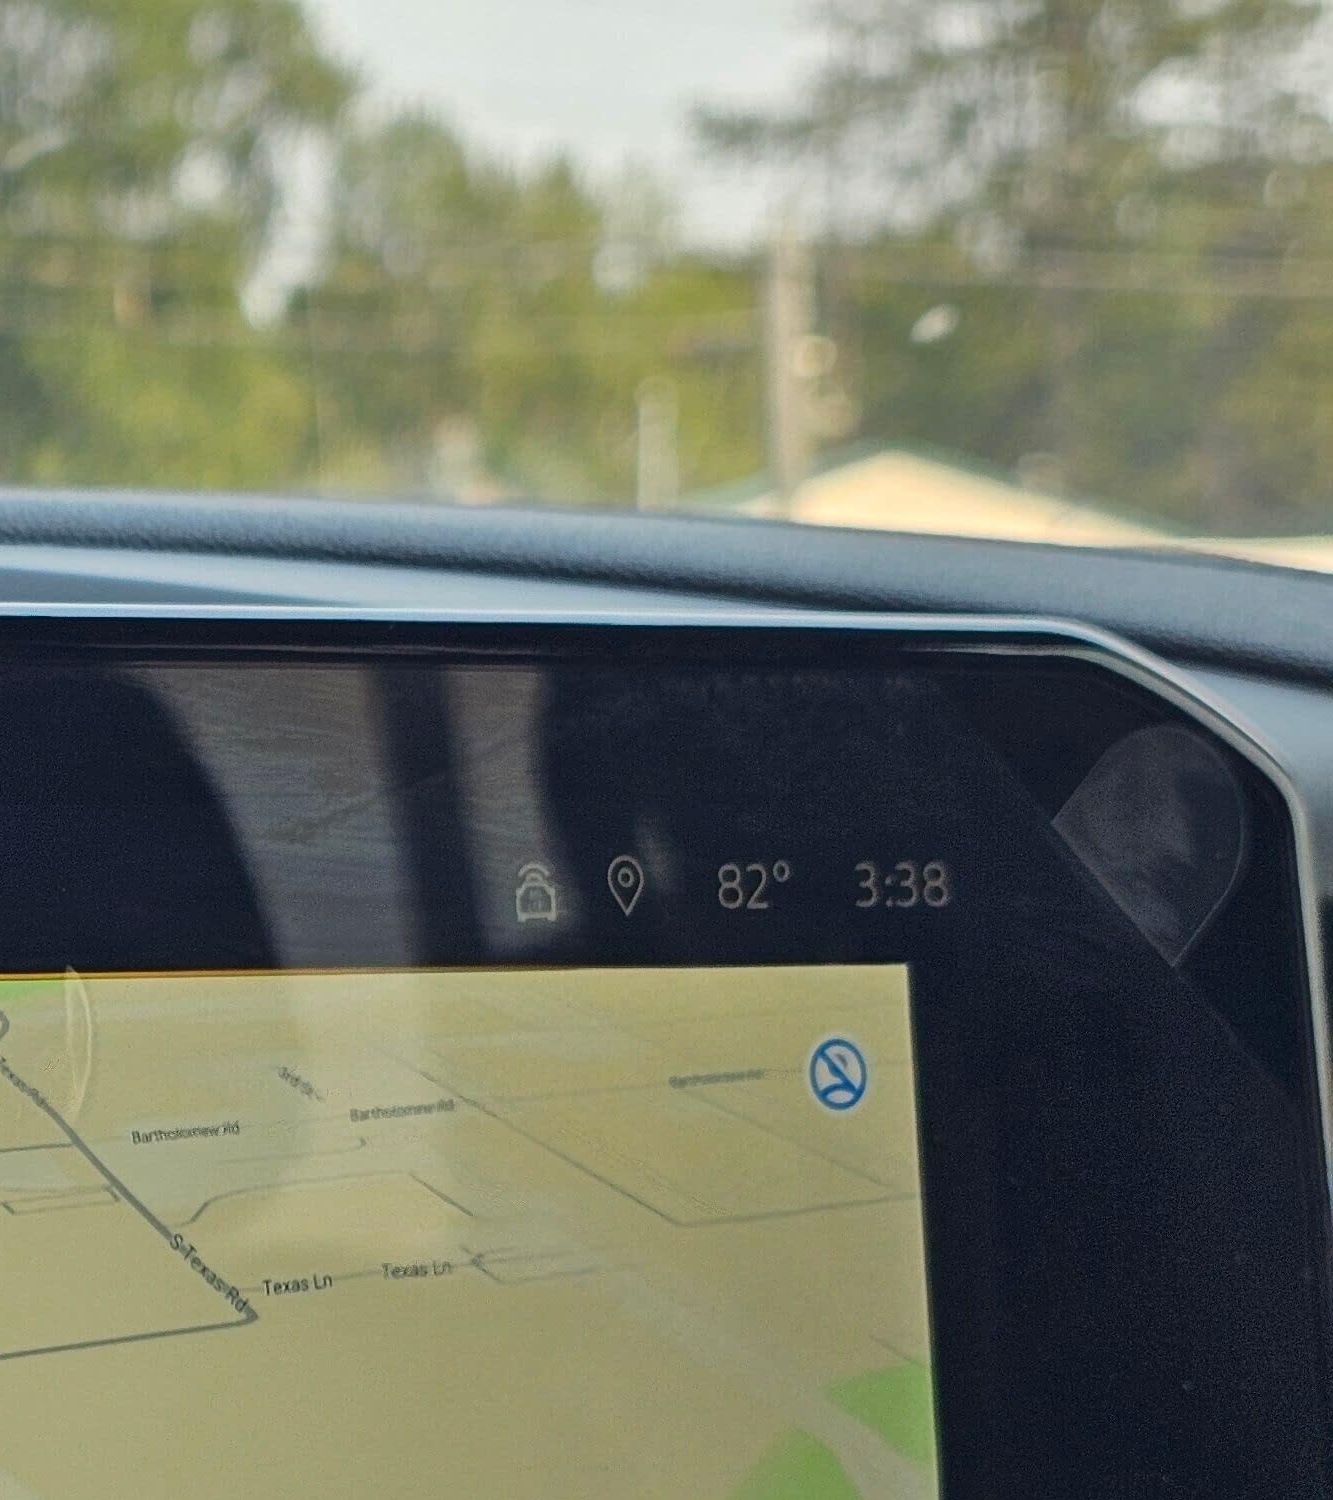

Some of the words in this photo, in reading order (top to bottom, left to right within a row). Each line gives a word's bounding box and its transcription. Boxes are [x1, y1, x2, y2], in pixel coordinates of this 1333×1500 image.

[717, 859, 791, 909] 82°
[854, 860, 953, 908] 3:38
[170, 1233, 183, 1251] S
[182, 1244, 227, 1292] Texas
[225, 1284, 250, 1312] Rd
[263, 1277, 309, 1296] Texas
[314, 1273, 333, 1290] Ln
